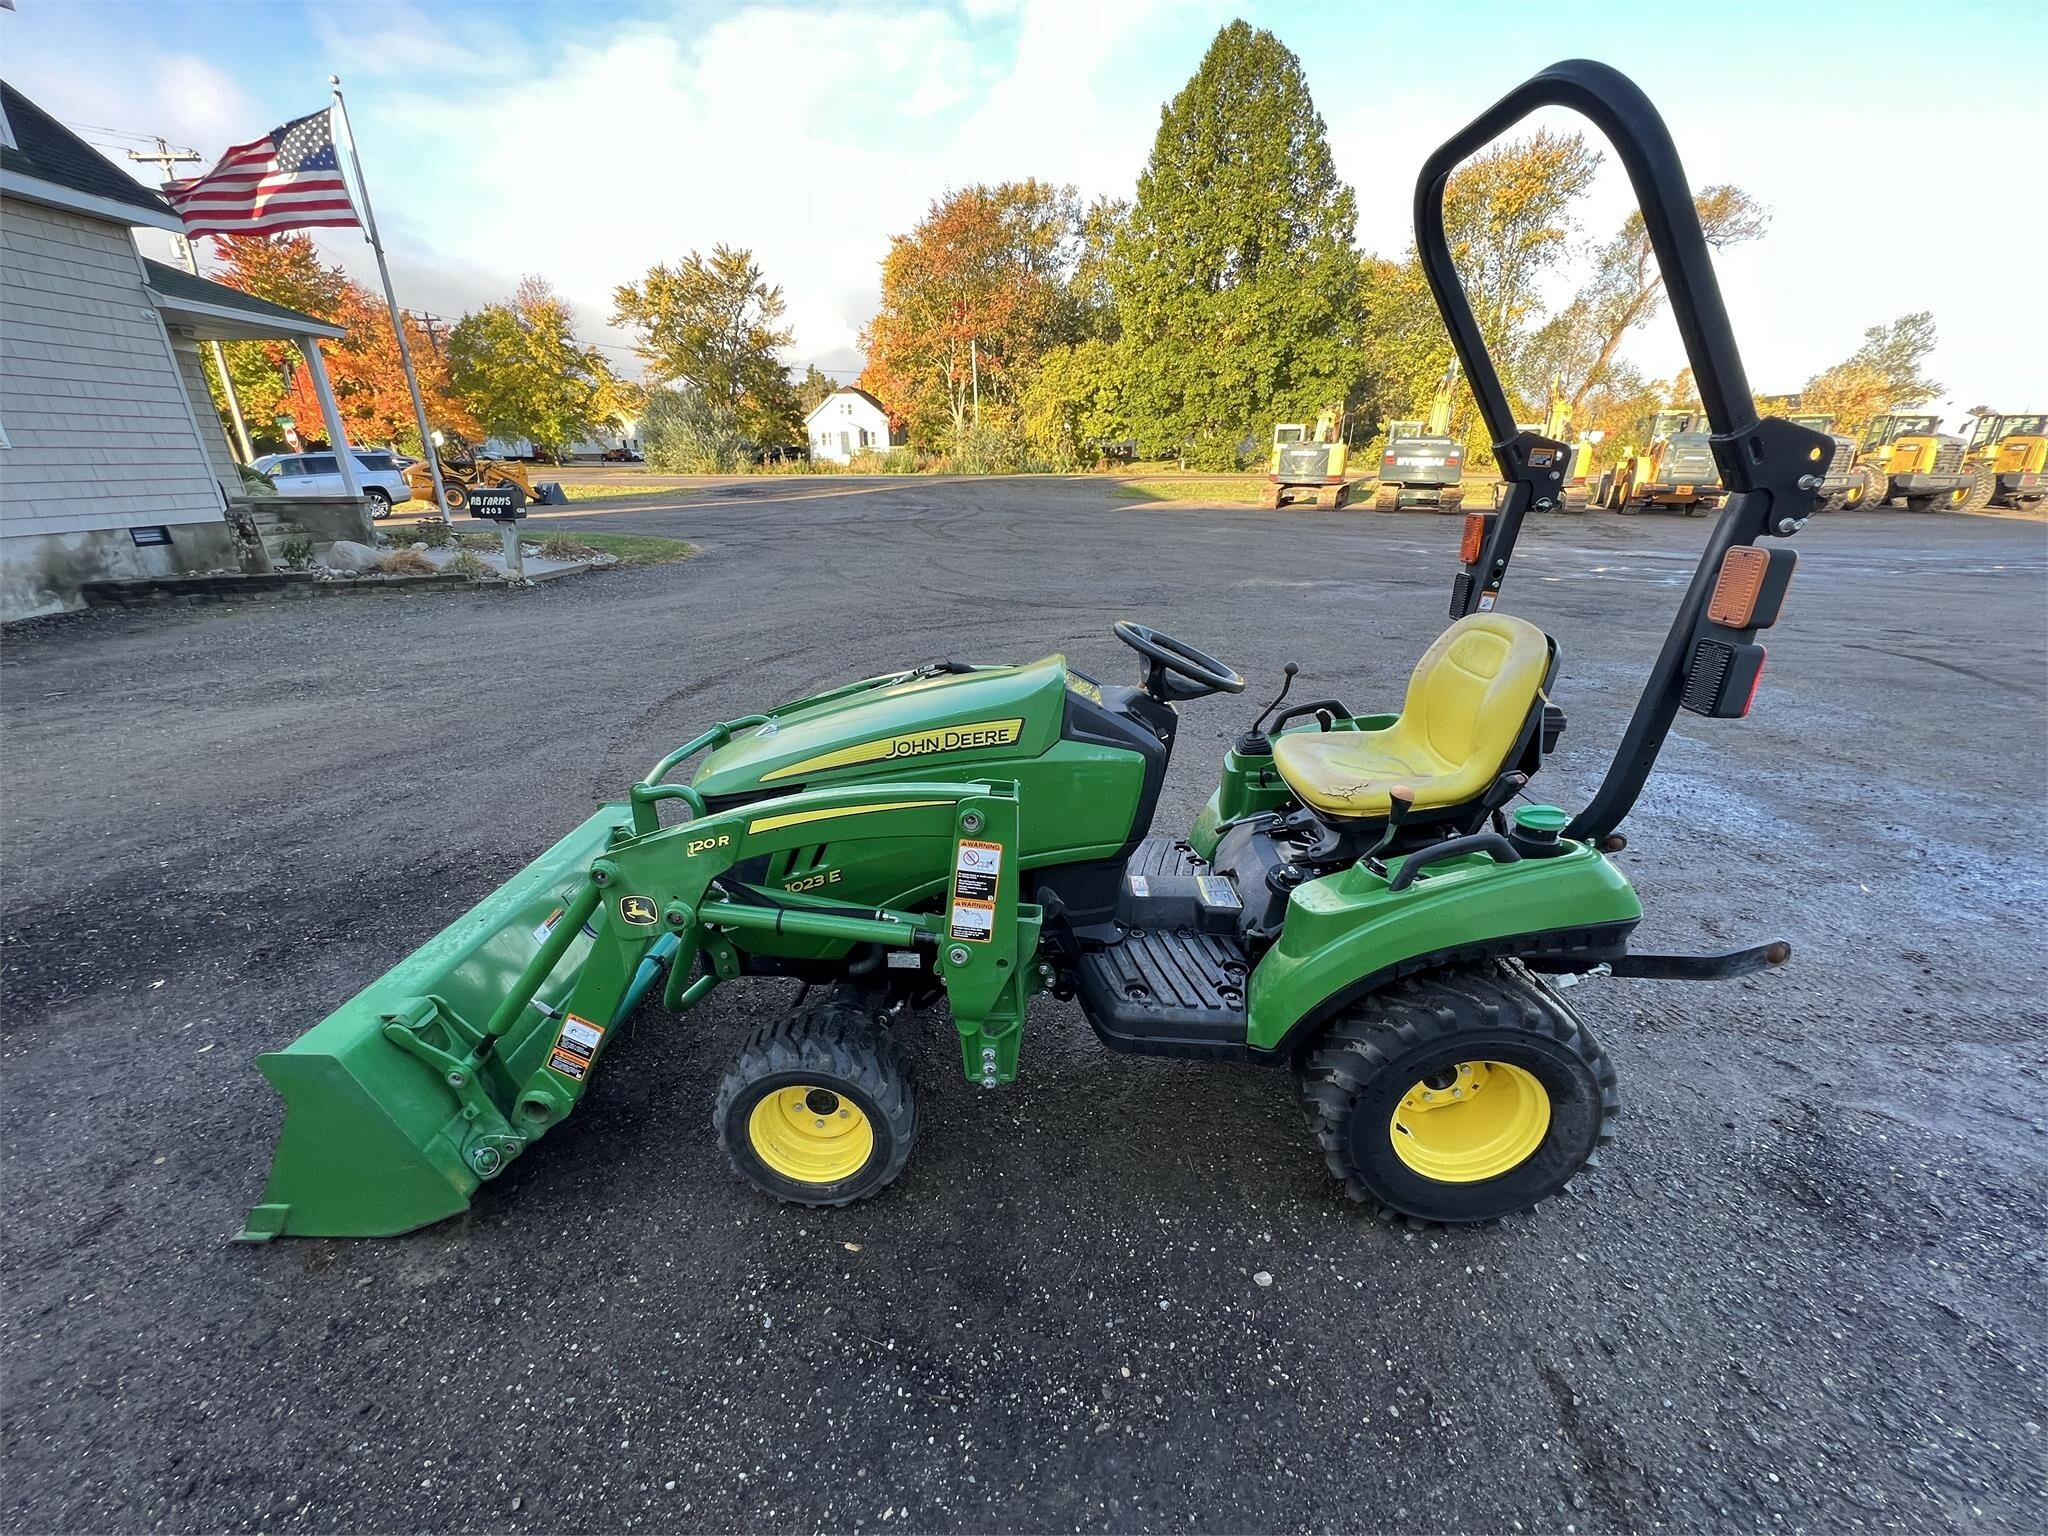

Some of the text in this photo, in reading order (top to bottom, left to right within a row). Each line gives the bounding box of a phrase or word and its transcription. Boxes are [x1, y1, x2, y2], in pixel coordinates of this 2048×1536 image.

[482, 496, 511, 506] FARMS
[480, 507, 502, 515] 4203
[885, 729, 1010, 757] JOHN DEERE
[688, 835, 730, 855] 120 R
[967, 841, 1000, 850] WARNING
[784, 869, 842, 892] 1023 E
[961, 901, 993, 910] WARNING
